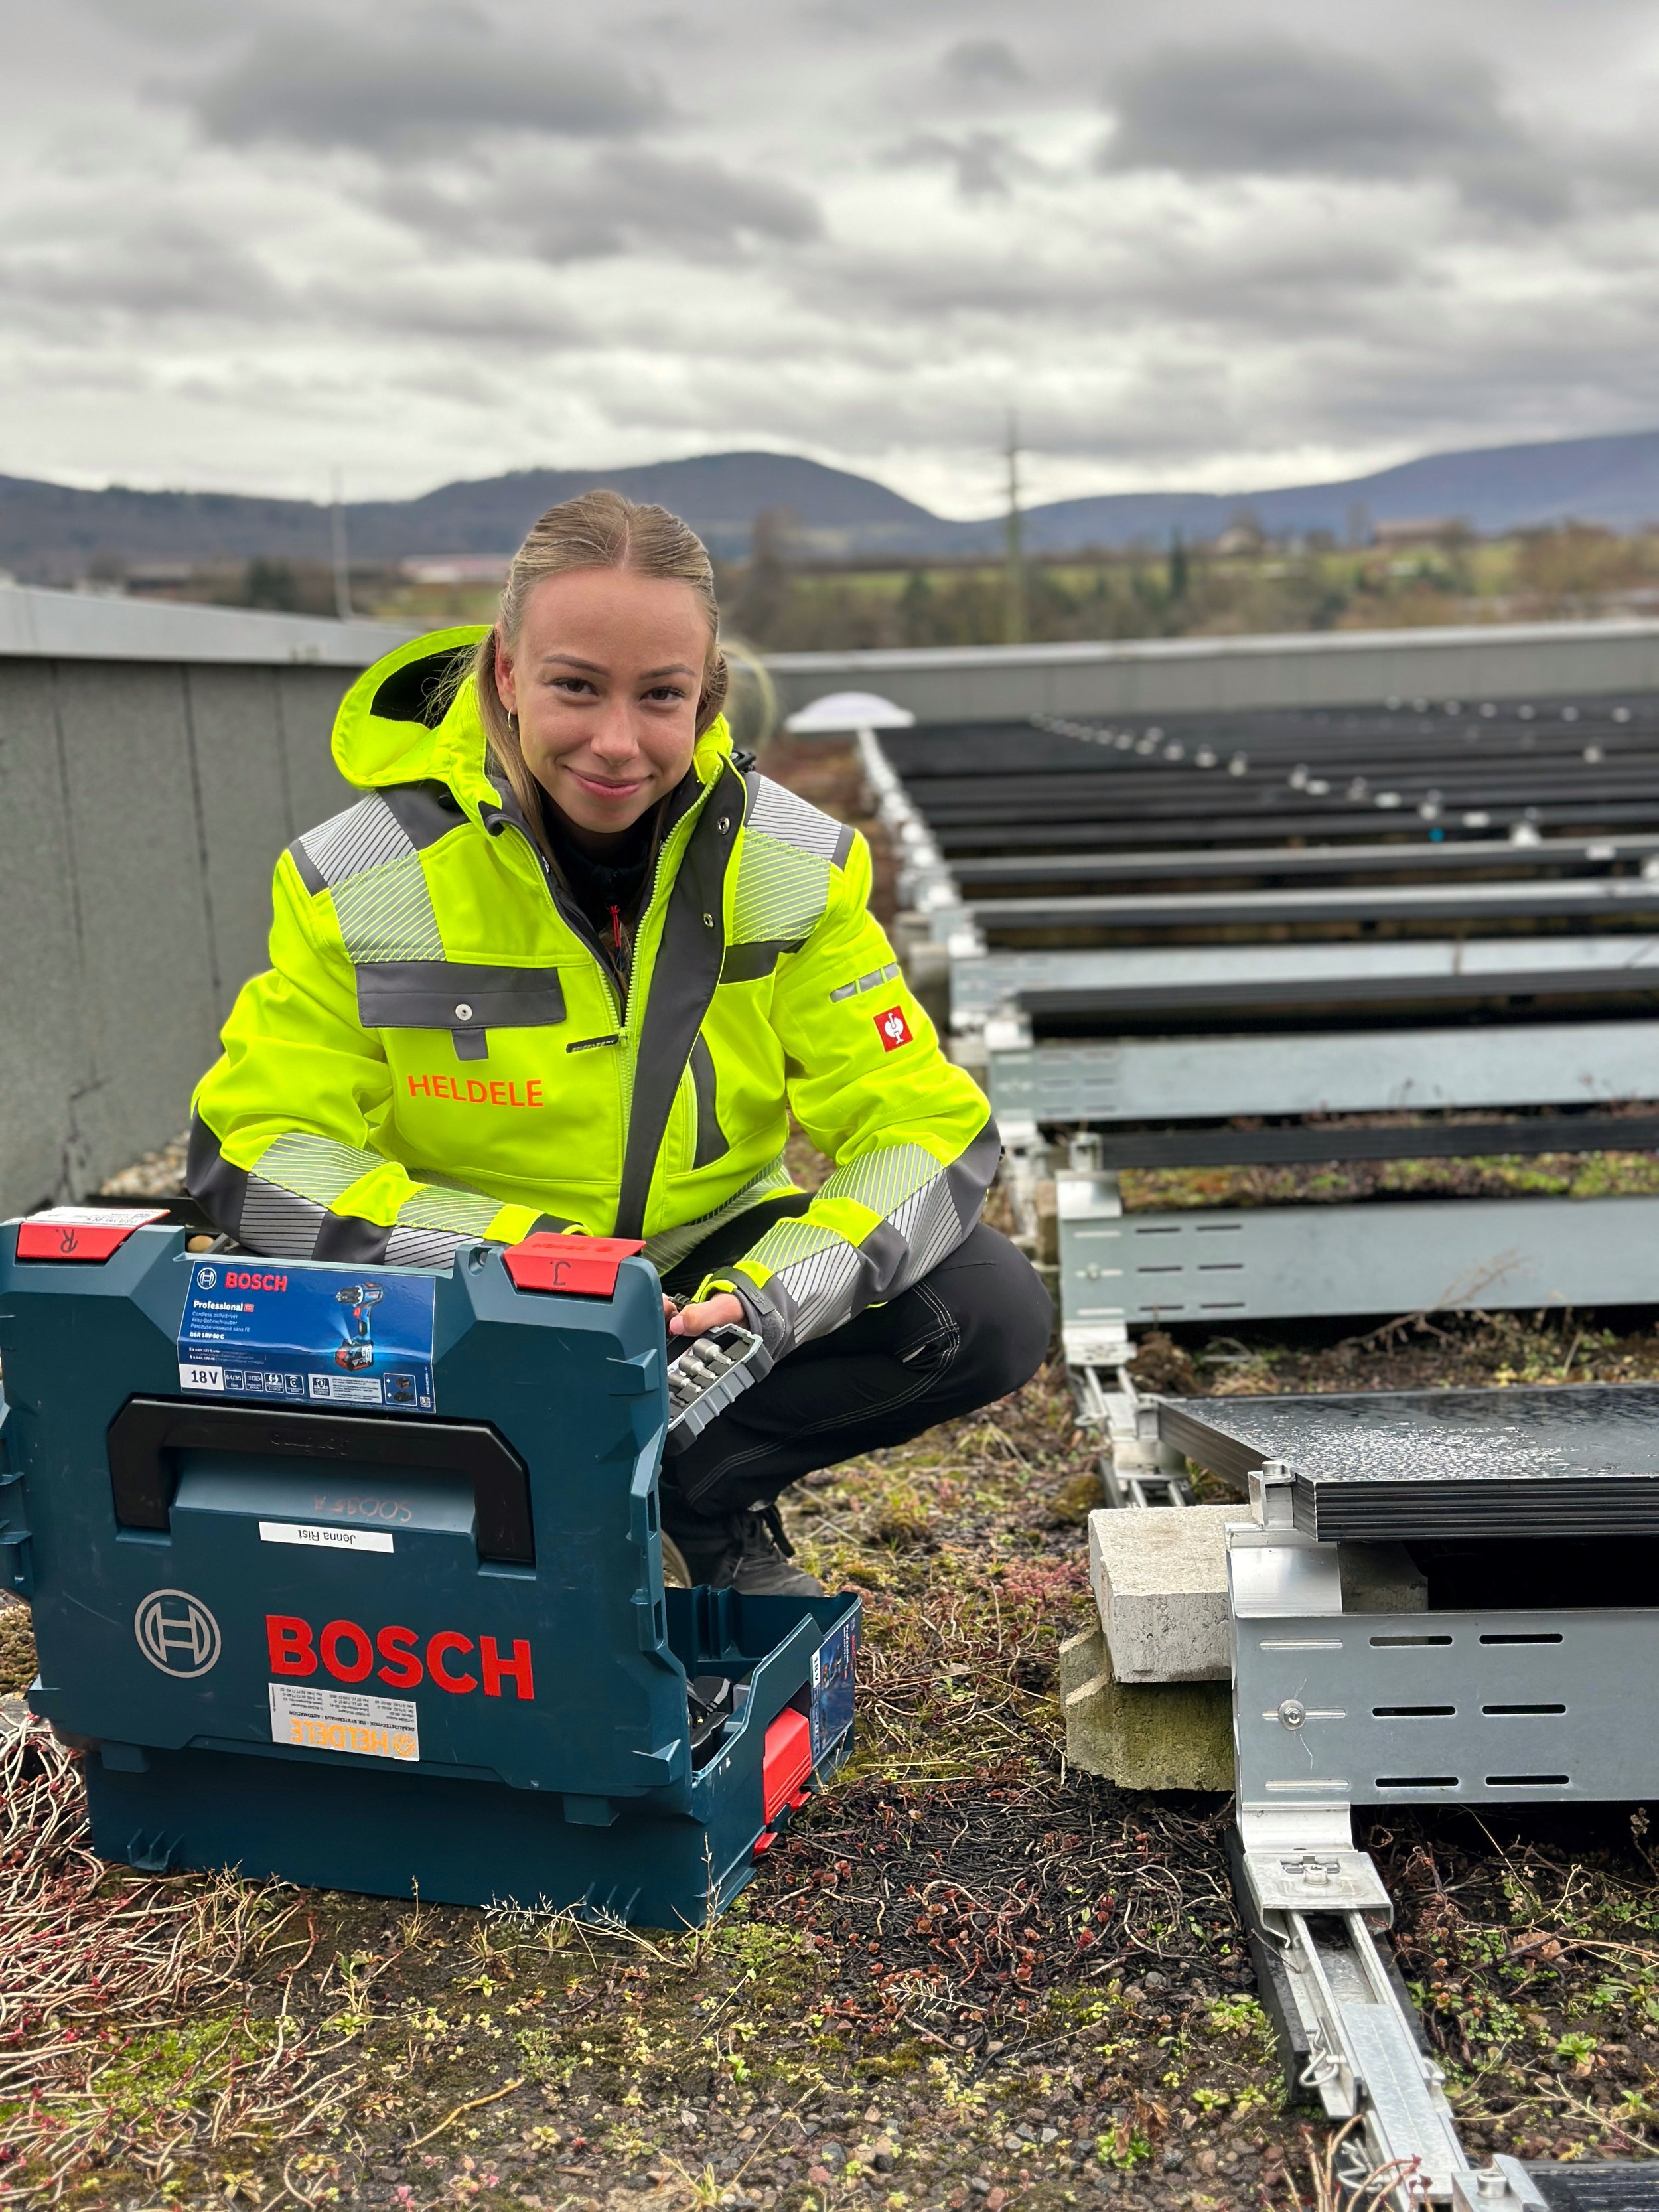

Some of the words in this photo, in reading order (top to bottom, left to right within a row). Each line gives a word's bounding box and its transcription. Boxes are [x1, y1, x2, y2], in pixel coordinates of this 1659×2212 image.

[407, 1074, 544, 1108] HELDELE
[225, 1272, 287, 1292] BOSCH
[193, 1300, 244, 1311] Professional
[298, 1529, 320, 1542] Rist
[324, 1533, 356, 1545] Jenna
[266, 1615, 534, 1700] BOSCH
[290, 1718, 388, 1755] HELDELE
